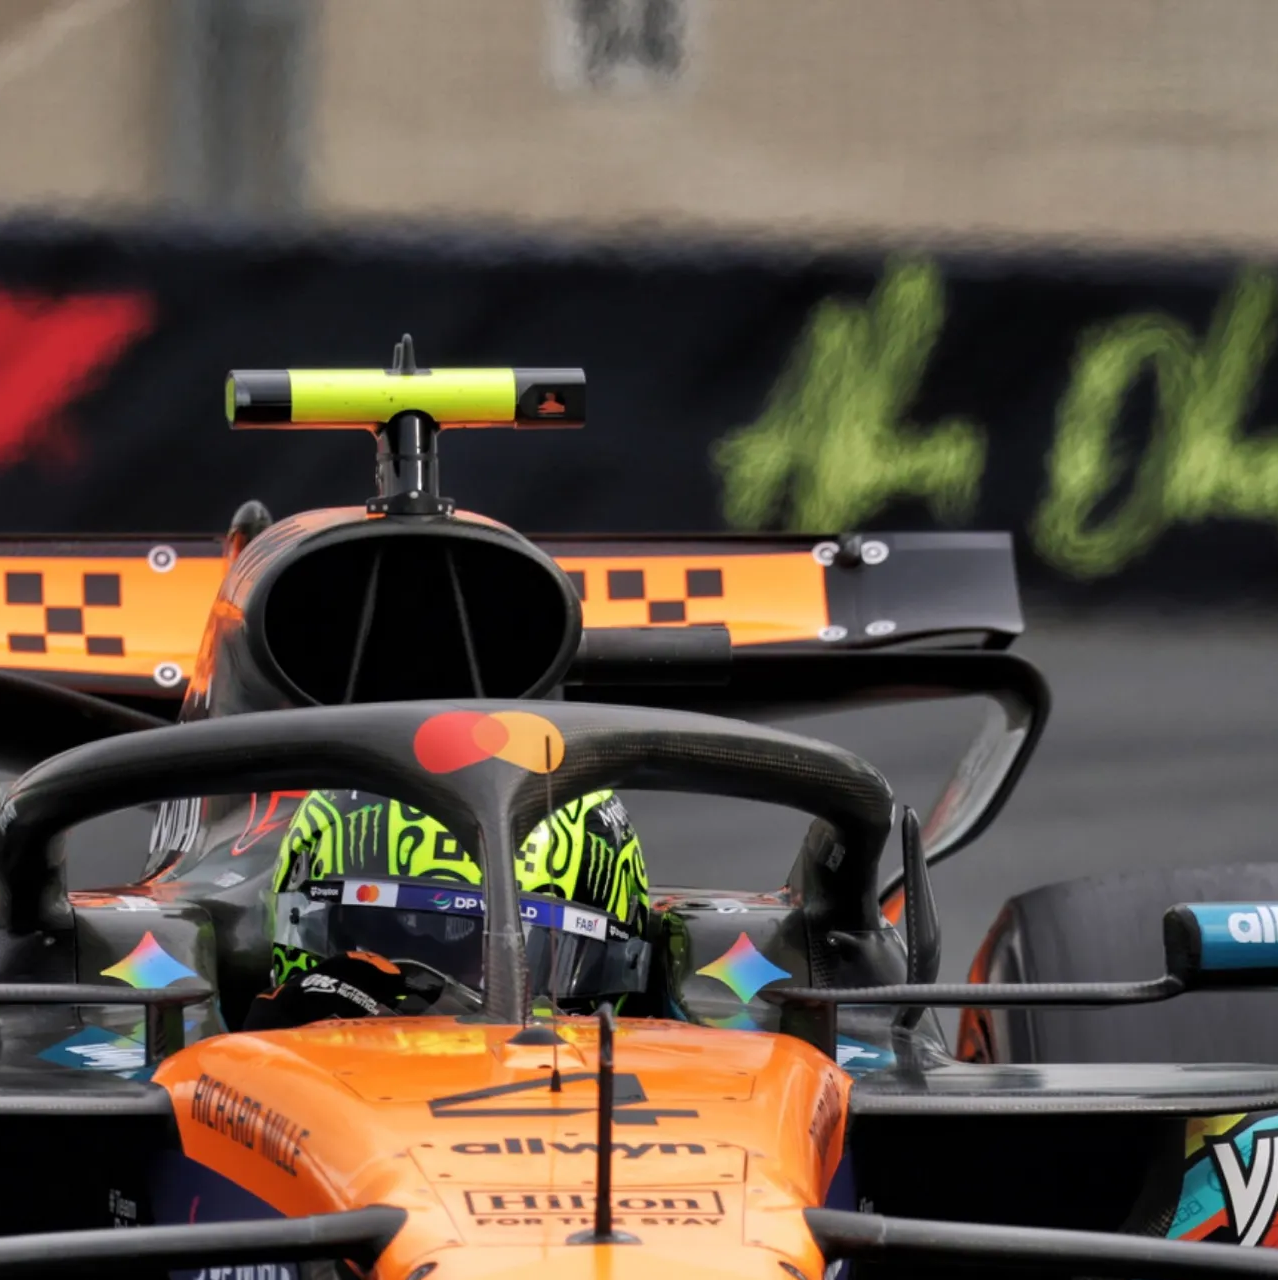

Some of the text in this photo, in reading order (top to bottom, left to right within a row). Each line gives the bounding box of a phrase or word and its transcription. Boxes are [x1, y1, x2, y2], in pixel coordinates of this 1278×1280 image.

[454, 896, 478, 911] DP
[427, 1073, 699, 1126] 4
[192, 1073, 310, 1177] RICHARD MILLE
[451, 1138, 707, 1160] allwyn
[489, 1195, 702, 1211] Hilon
[476, 1218, 545, 1227] FOR
[641, 1218, 723, 1227] STAY
